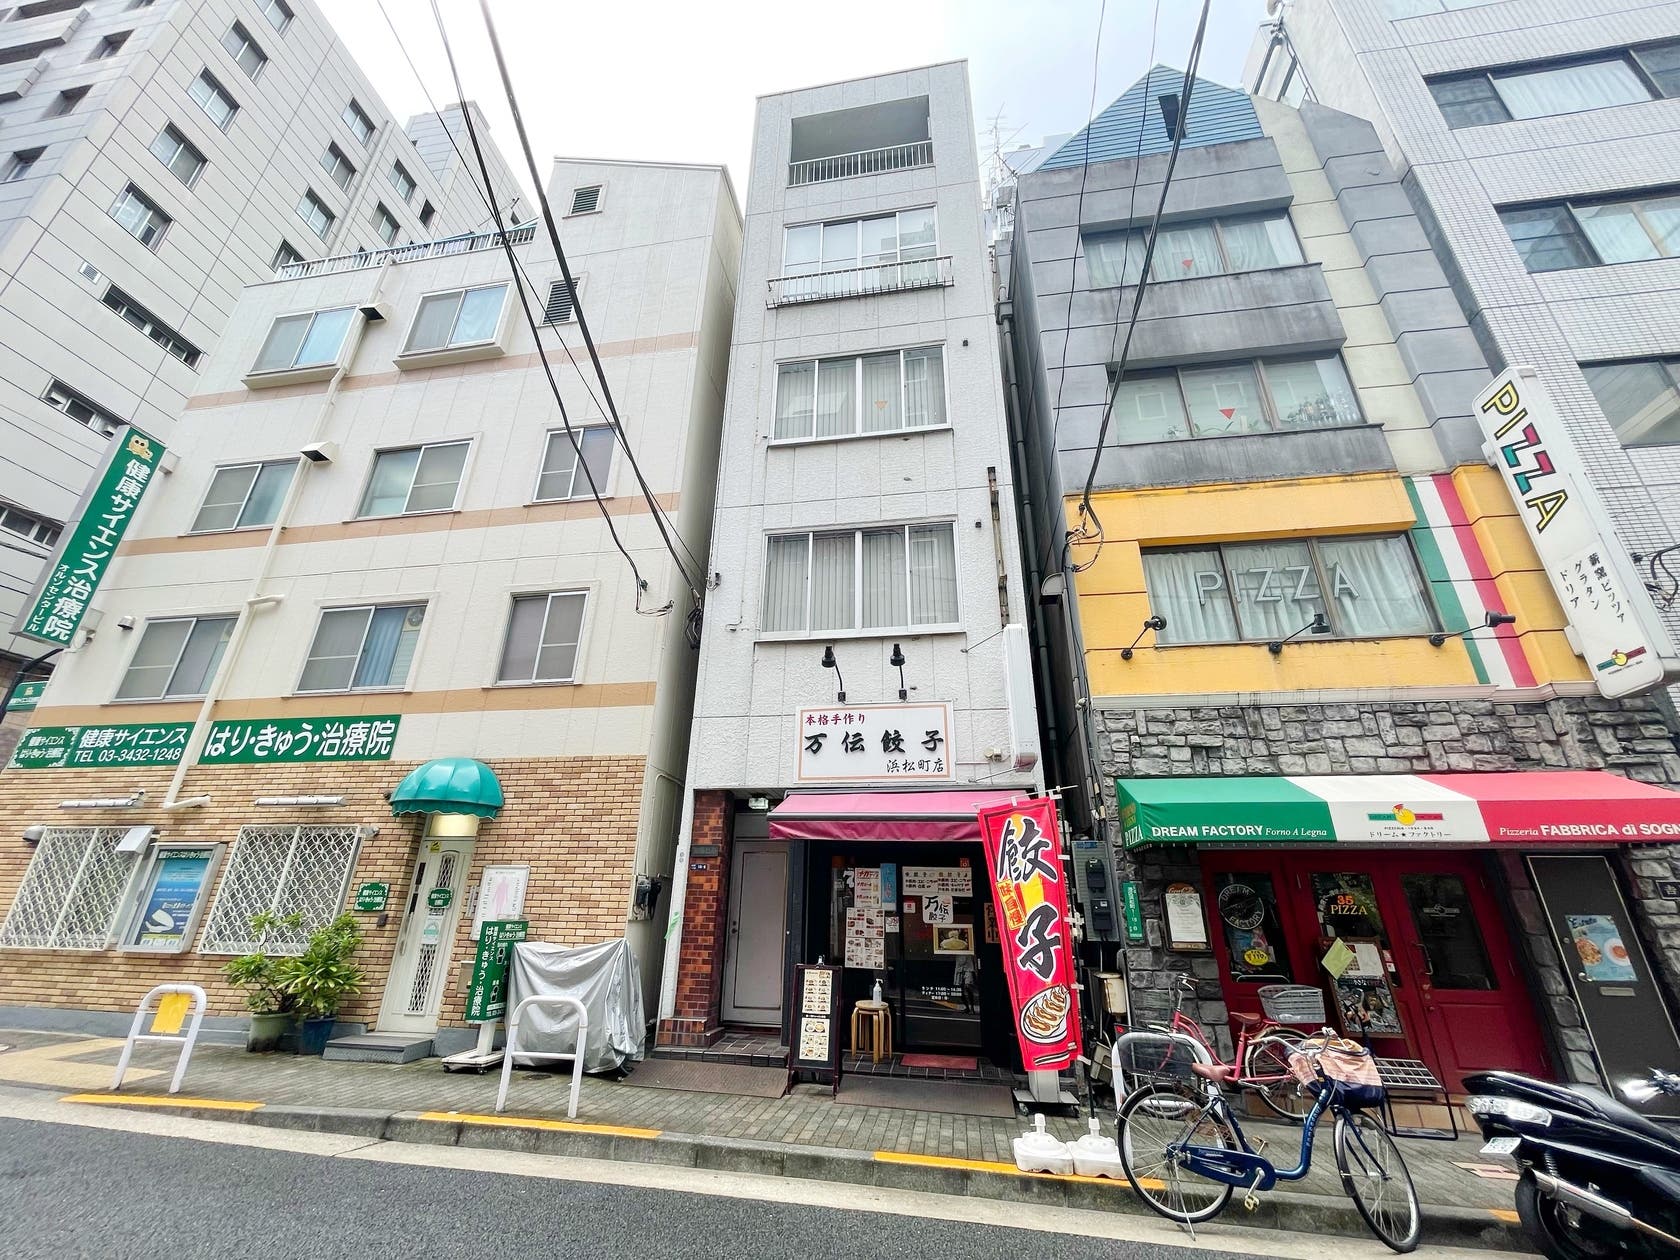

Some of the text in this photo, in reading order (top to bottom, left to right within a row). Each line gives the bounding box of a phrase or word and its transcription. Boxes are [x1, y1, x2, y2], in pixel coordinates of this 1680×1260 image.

[1481, 380, 1568, 534] PIZZA
[42, 459, 150, 640] 健康サイエンス治療院
[1195, 561, 1360, 606] PIZZA
[1560, 570, 1579, 608] ドリア
[1575, 560, 1599, 610] グラタン
[806, 713, 865, 726] 本格手作り
[79, 728, 187, 748] 健康サイエンス
[205, 720, 395, 757] はり・きゅう・治療院
[804, 729, 944, 755] 万伝餃子
[73, 747, 182, 763] TEL 03-3432-1248
[886, 758, 944, 773] 浜松町店
[1124, 824, 1144, 847] PIZZA
[1151, 825, 1328, 838] DREAM FACTORY Forno A Legna
[1499, 828, 1539, 836] Pizzeria
[1540, 824, 1619, 836] FABBRICA
[1622, 824, 1637, 836] di
[997, 815, 1061, 983] 餃子
[1331, 905, 1368, 915] PIZZA
